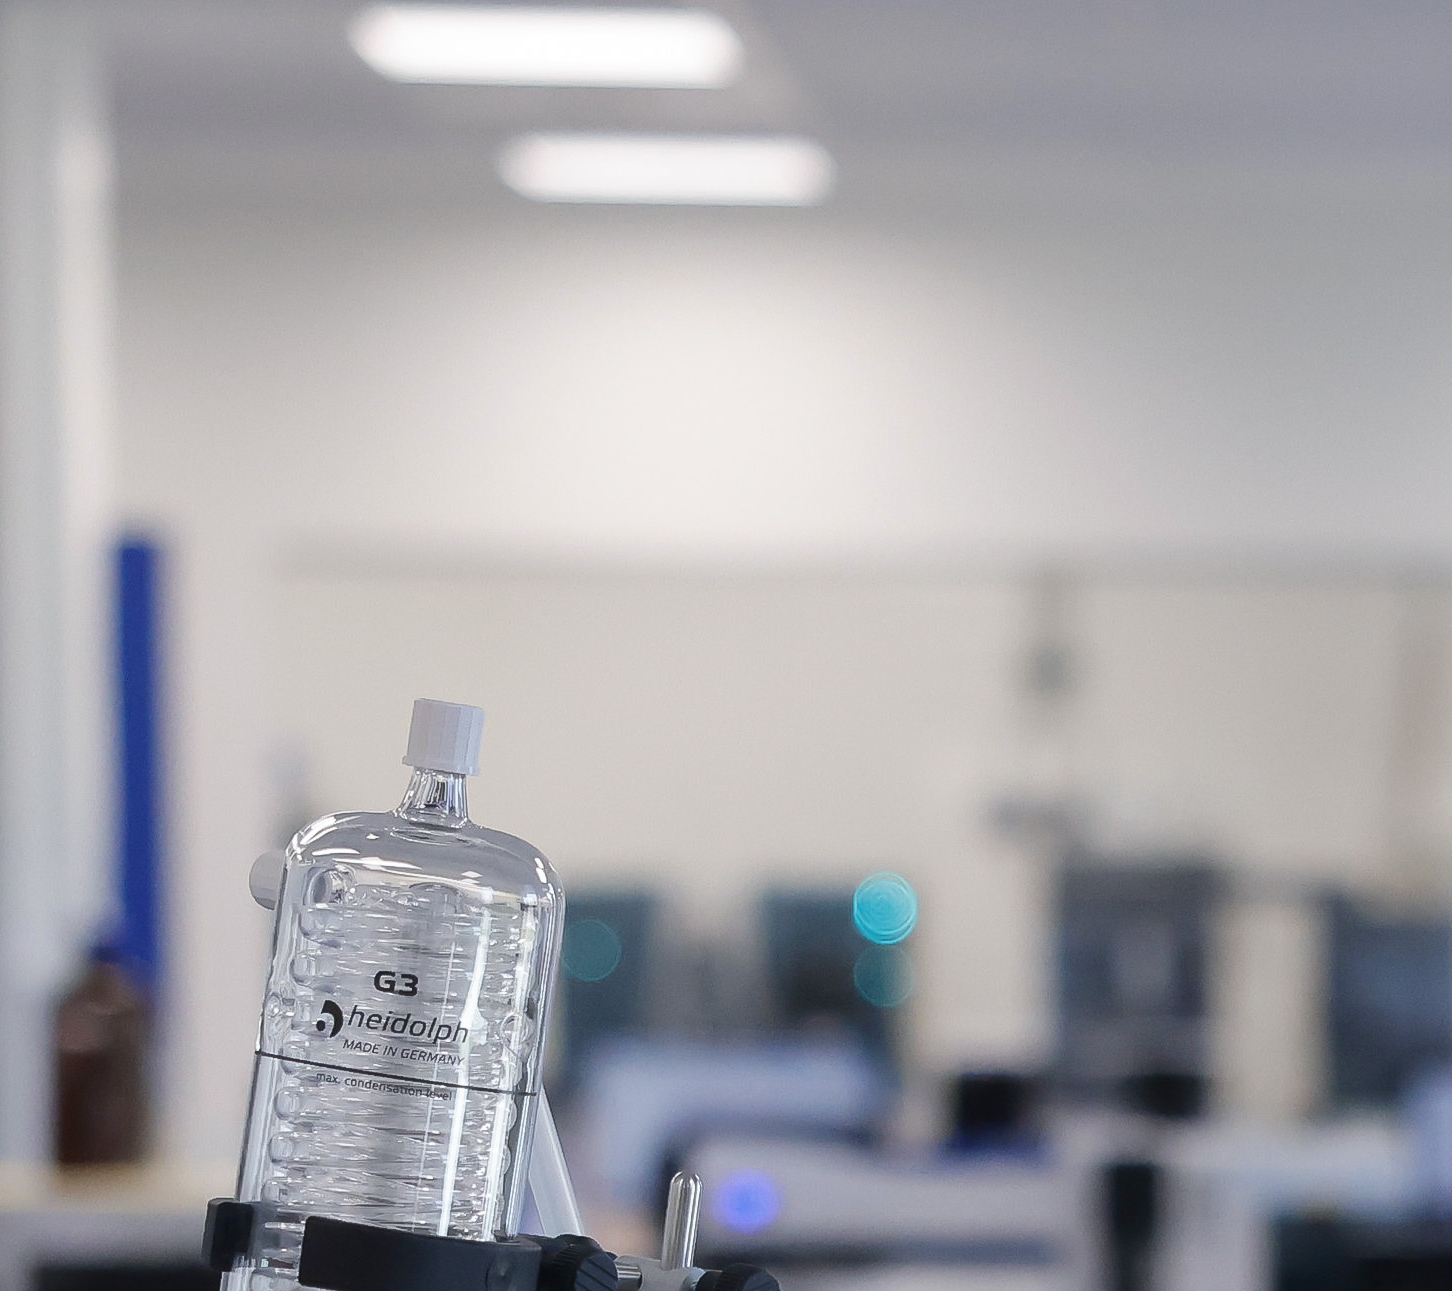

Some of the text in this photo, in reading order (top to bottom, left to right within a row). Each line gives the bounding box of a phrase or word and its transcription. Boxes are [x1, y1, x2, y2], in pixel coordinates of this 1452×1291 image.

[373, 970, 419, 996] G3
[347, 1005, 469, 1044] heidolph
[343, 1039, 466, 1066] MADE IN GERMANY
[316, 1072, 452, 1101] max. condensation level
